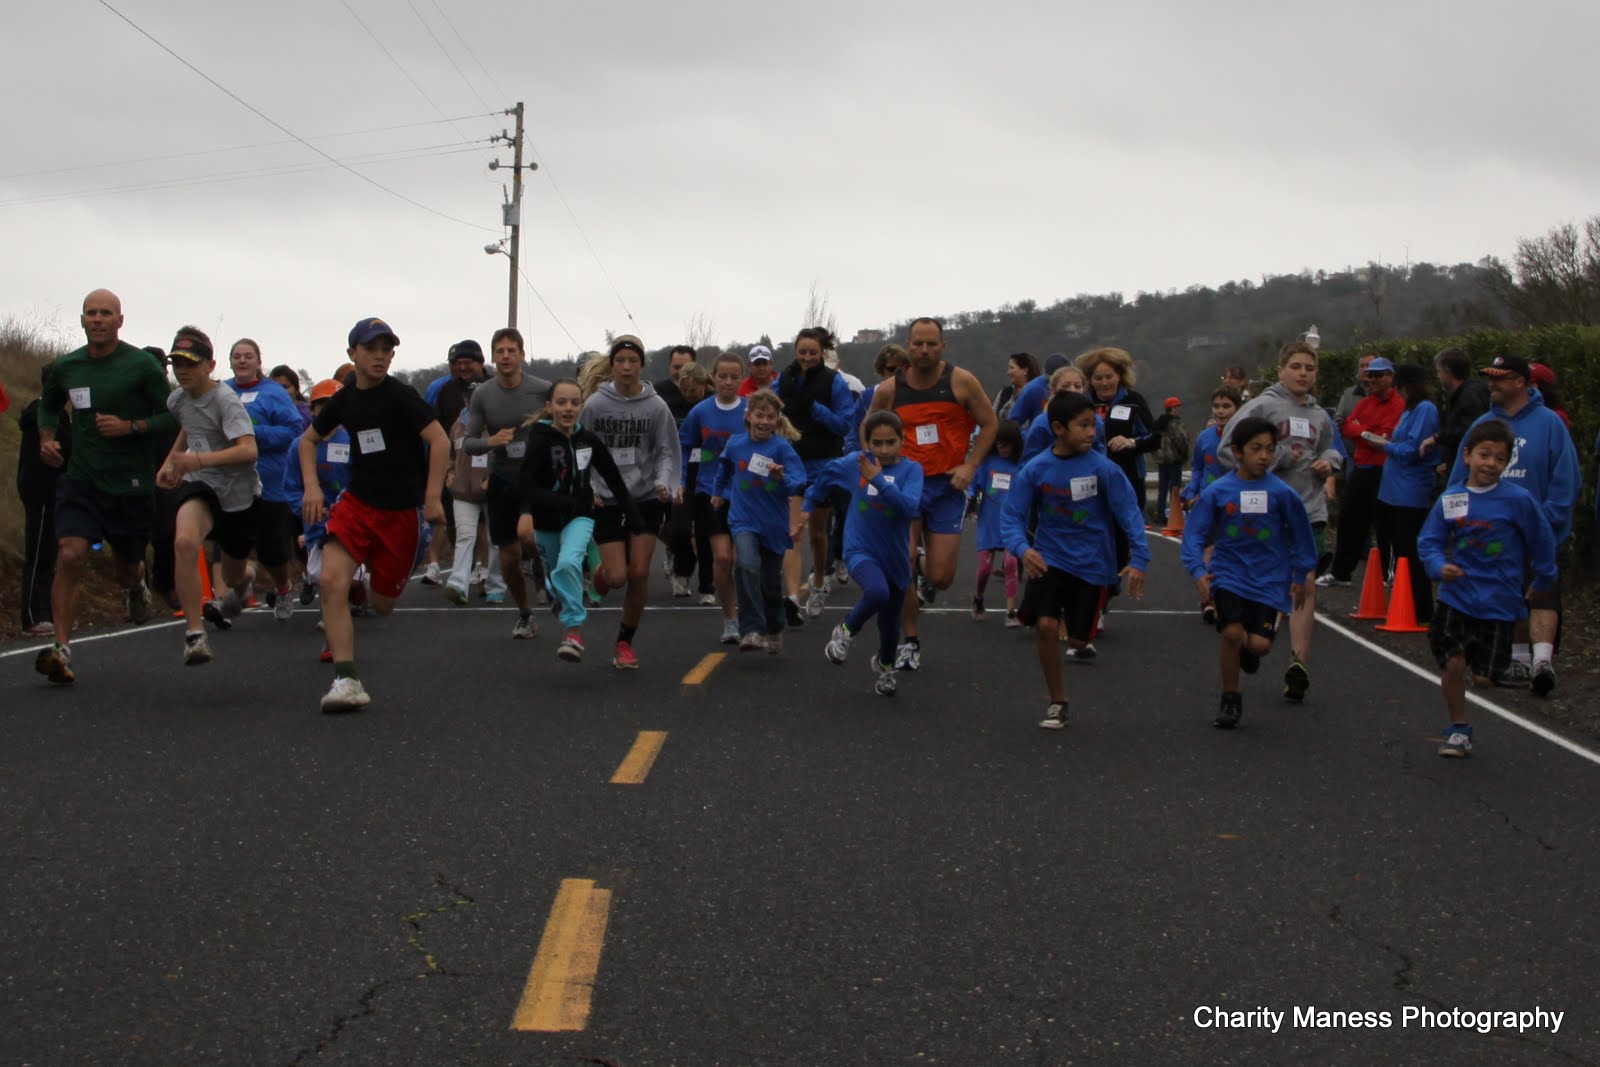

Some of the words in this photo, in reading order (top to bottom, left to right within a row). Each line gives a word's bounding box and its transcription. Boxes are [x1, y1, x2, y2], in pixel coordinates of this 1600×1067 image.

[593, 417, 651, 434] BASKETBALL
[618, 434, 641, 448] LIFE
[923, 431, 931, 440] 19
[1248, 497, 1259, 505] 32
